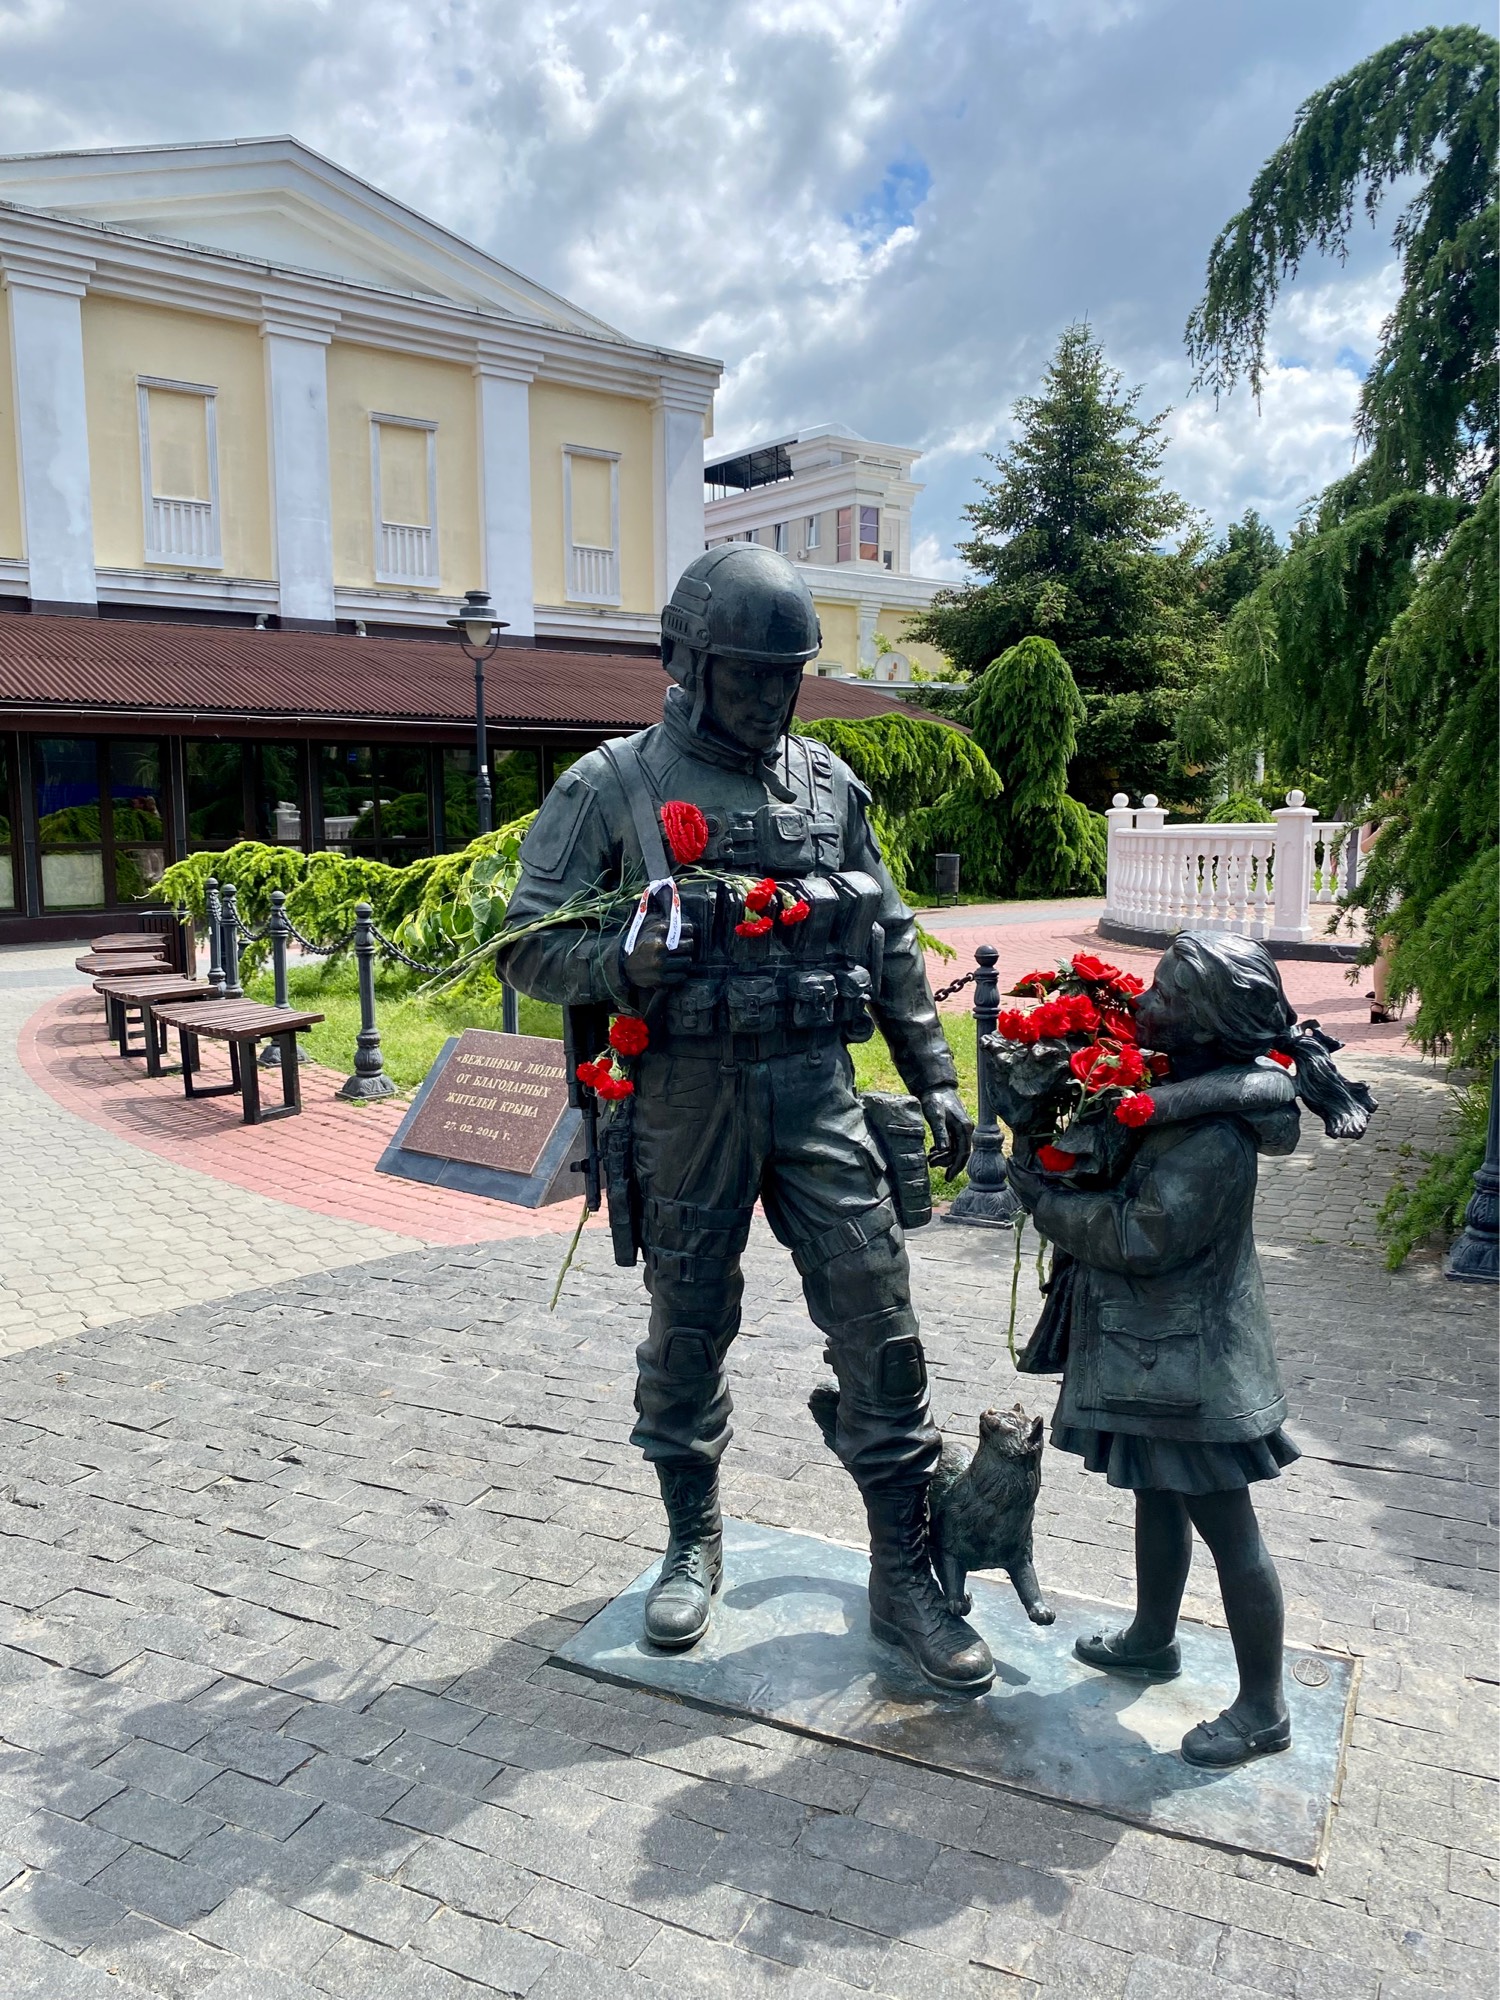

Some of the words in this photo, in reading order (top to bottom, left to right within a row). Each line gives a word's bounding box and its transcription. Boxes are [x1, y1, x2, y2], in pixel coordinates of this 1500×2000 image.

[456, 1073, 471, 1084] ОТ
[473, 1076, 551, 1098] БЛАГОДАРНЫХ
[445, 1092, 498, 1110] ЖИТЕЛЕЙ
[499, 1101, 539, 1118] КРЫМА
[476, 1127, 499, 1140] 2014
